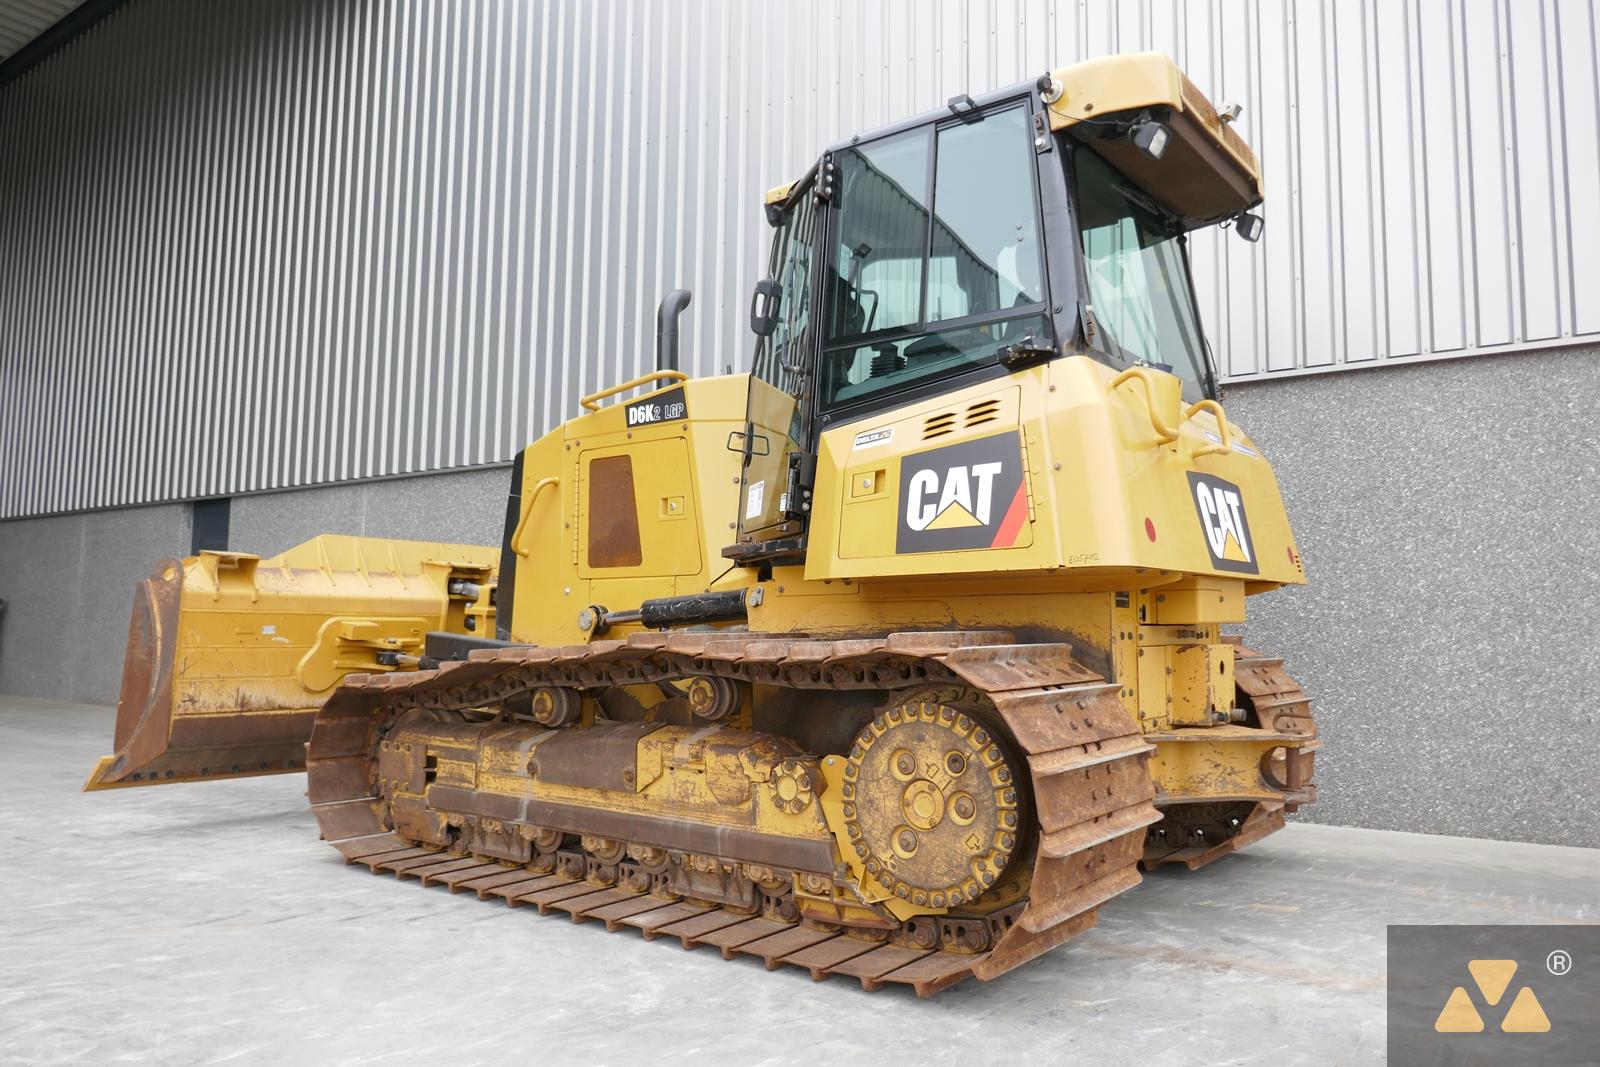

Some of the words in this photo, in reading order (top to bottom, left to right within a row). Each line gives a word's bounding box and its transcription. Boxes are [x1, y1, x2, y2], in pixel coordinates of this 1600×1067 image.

[629, 403, 660, 425] D6K2
[664, 402, 684, 419] LGP
[906, 461, 1002, 531] CAT
[1196, 481, 1251, 563] CAT
